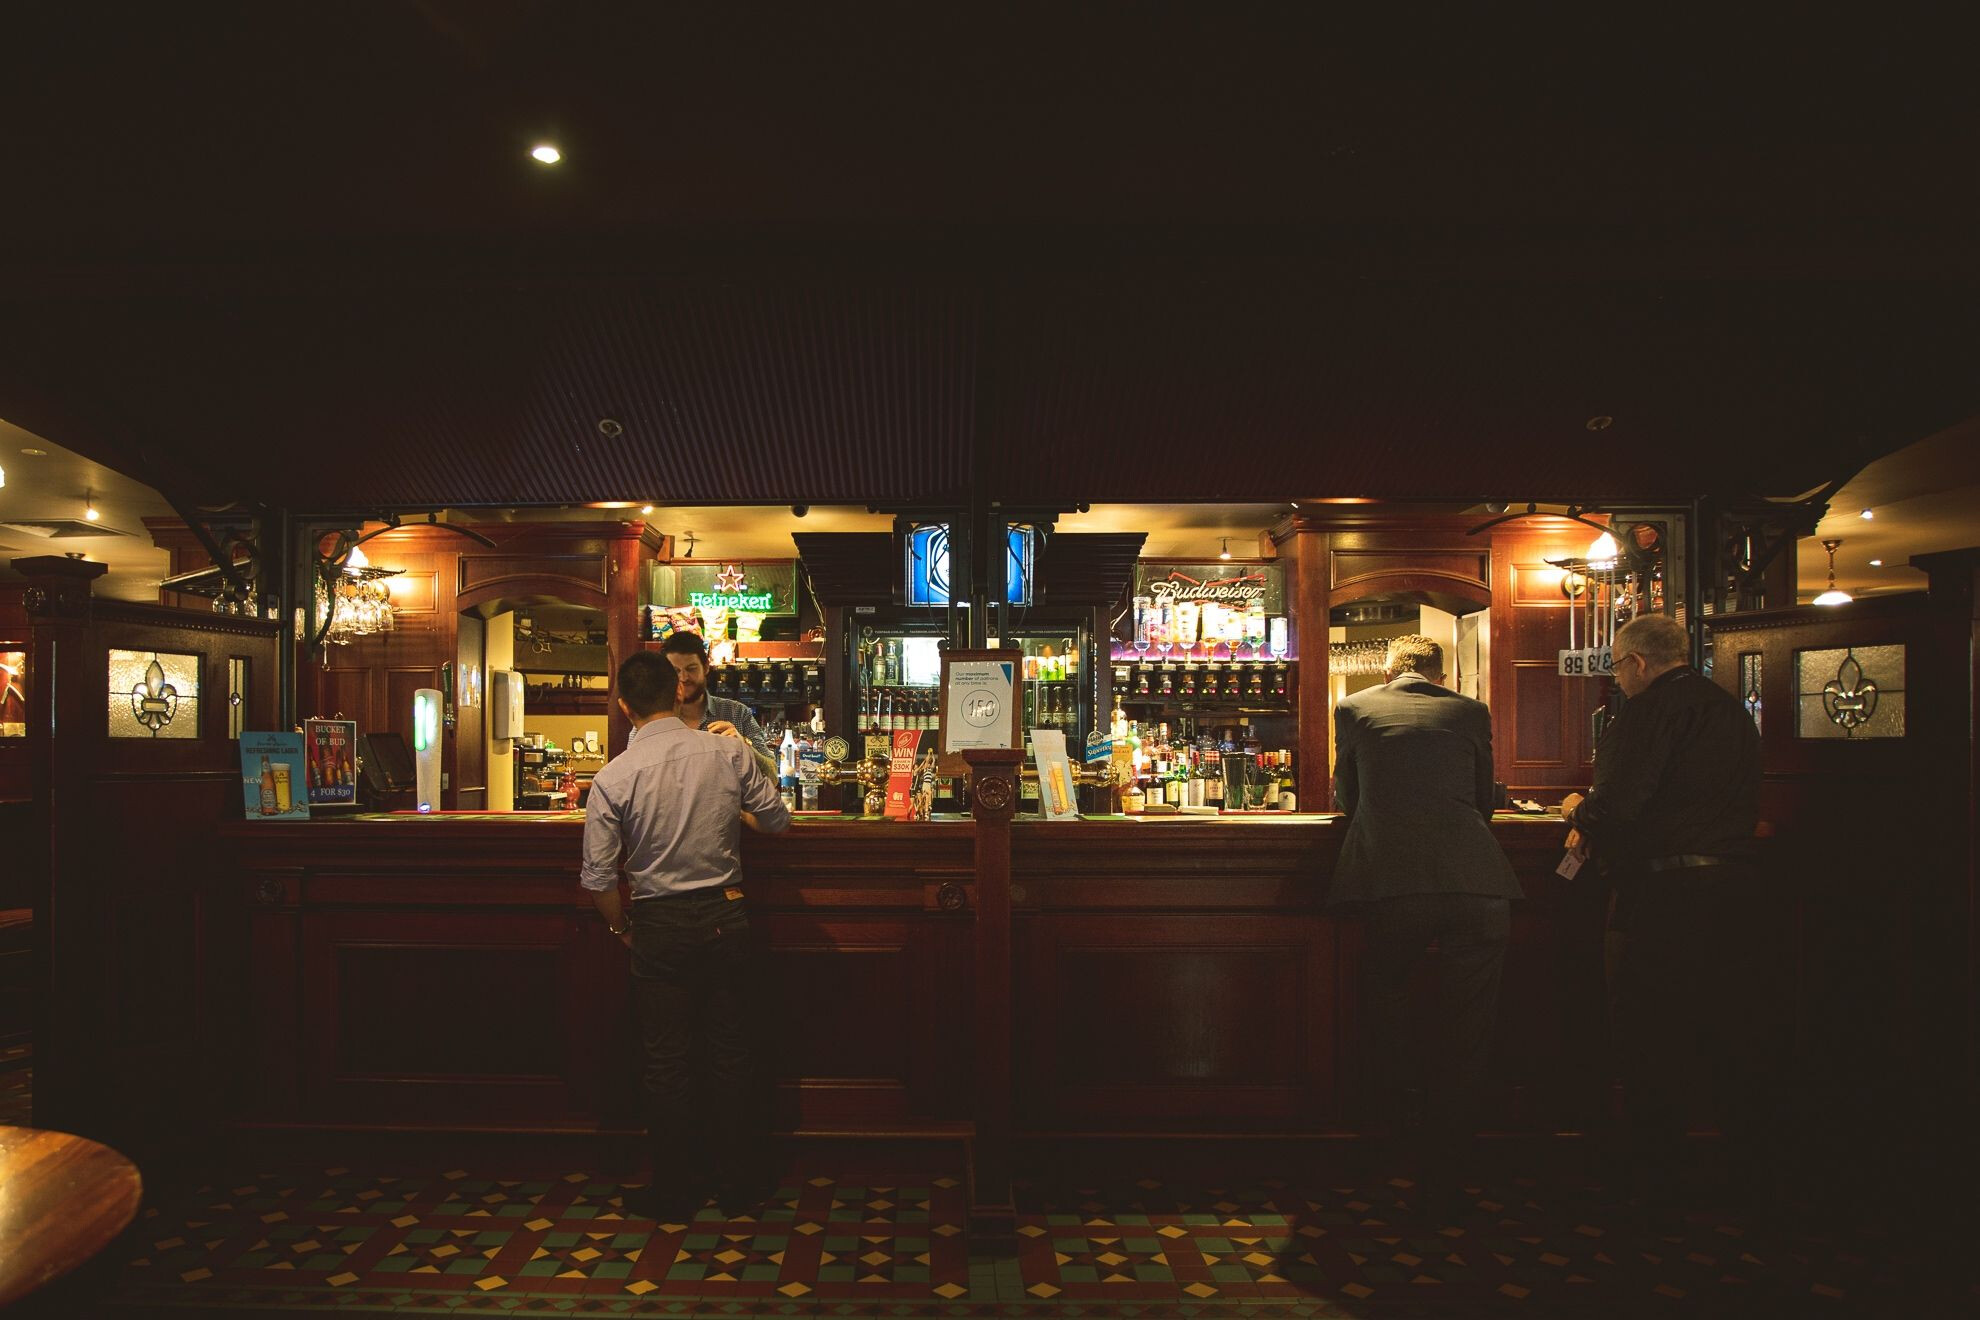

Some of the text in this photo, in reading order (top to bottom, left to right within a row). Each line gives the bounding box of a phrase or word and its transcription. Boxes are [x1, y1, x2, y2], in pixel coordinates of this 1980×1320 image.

[1150, 580, 1265, 601] Budweiser
[689, 593, 770, 609] Heineken
[315, 725, 346, 734] BUCKET
[316, 737, 346, 746] OF BUD
[894, 748, 913, 757] WIN
[320, 788, 336, 796] FOR
[336, 789, 351, 797] $30
